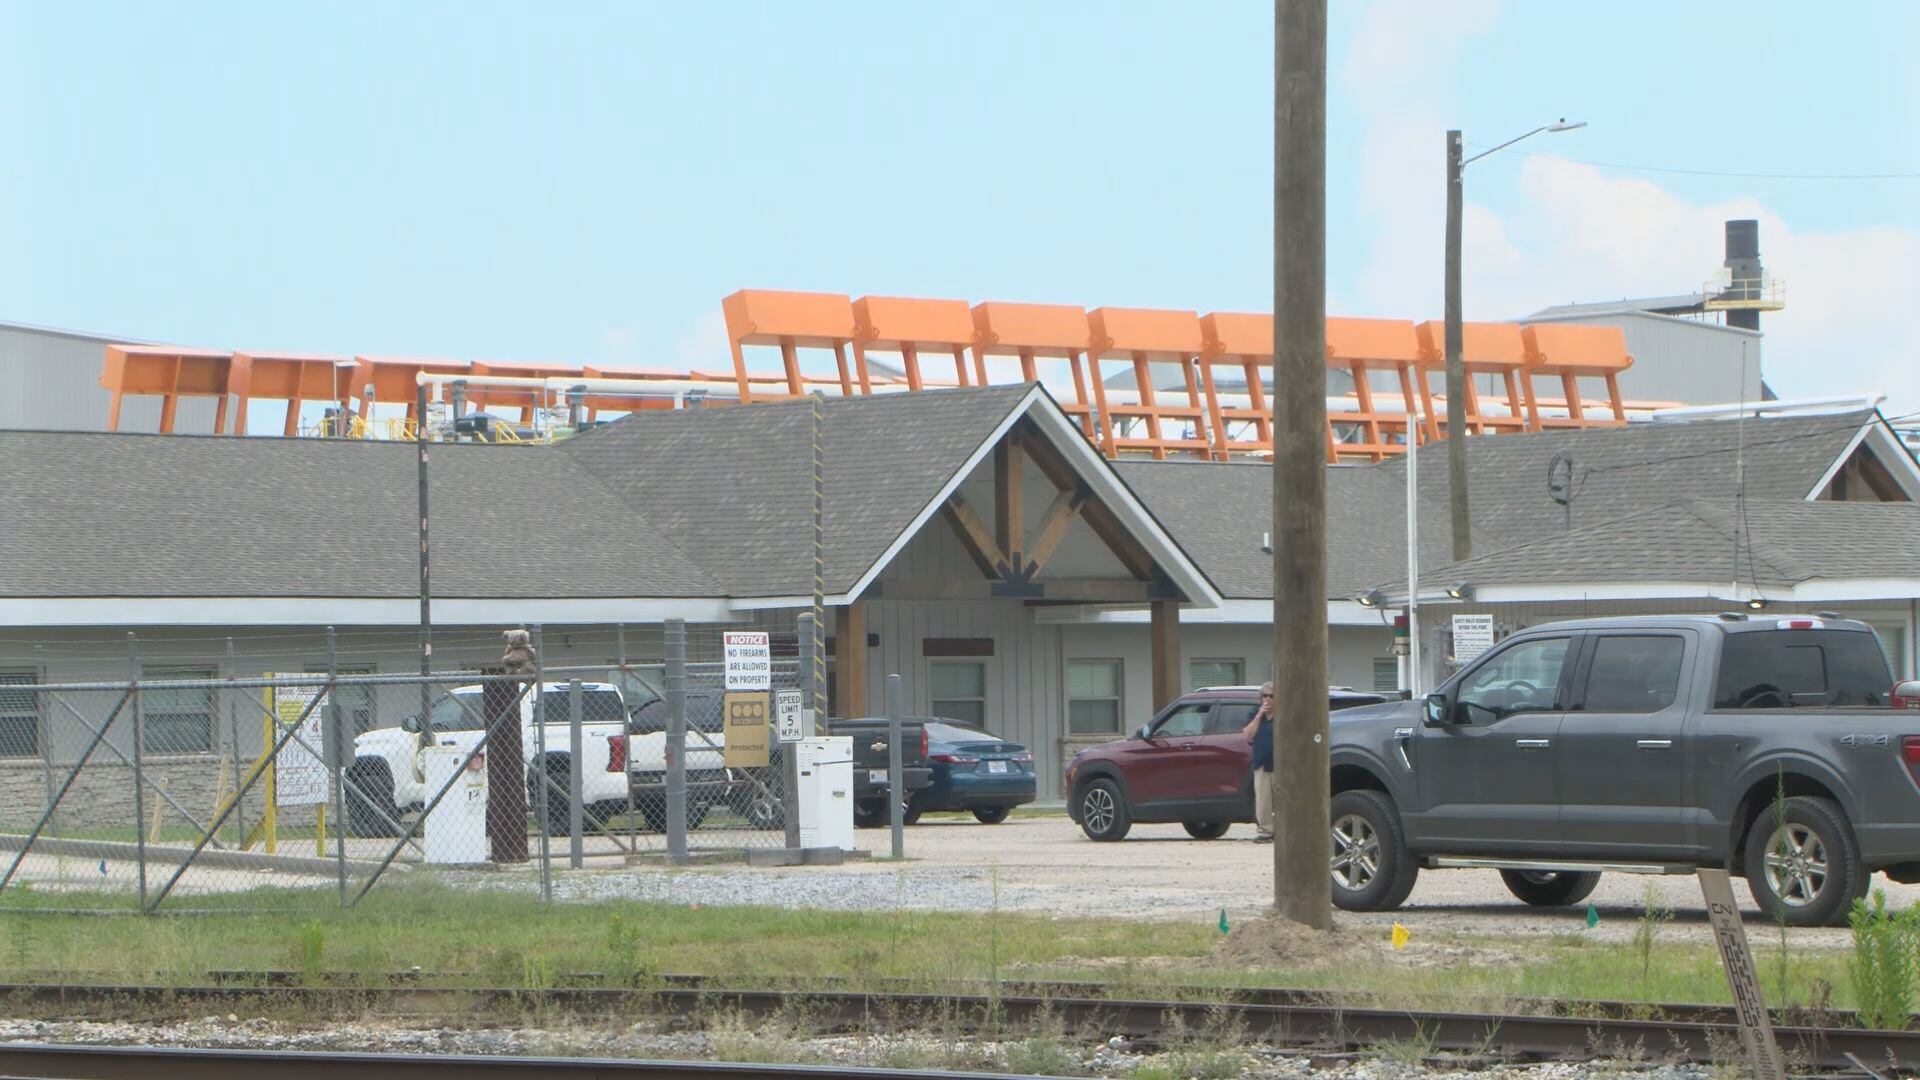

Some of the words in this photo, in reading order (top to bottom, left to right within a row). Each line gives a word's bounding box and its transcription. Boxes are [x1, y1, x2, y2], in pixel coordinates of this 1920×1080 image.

[731, 636, 764, 645] NOTICE
[728, 649, 737, 658] NO
[740, 649, 767, 658] FIREARMS
[730, 662, 740, 671] ARE
[742, 662, 767, 671] ALLOWED
[729, 675, 739, 684] ON
[740, 675, 768, 684] PROPERTY
[779, 696, 800, 704] SPEED
[782, 705, 798, 713] LIMIT
[787, 715, 794, 726] 5
[1711, 903, 1733, 915] CN
